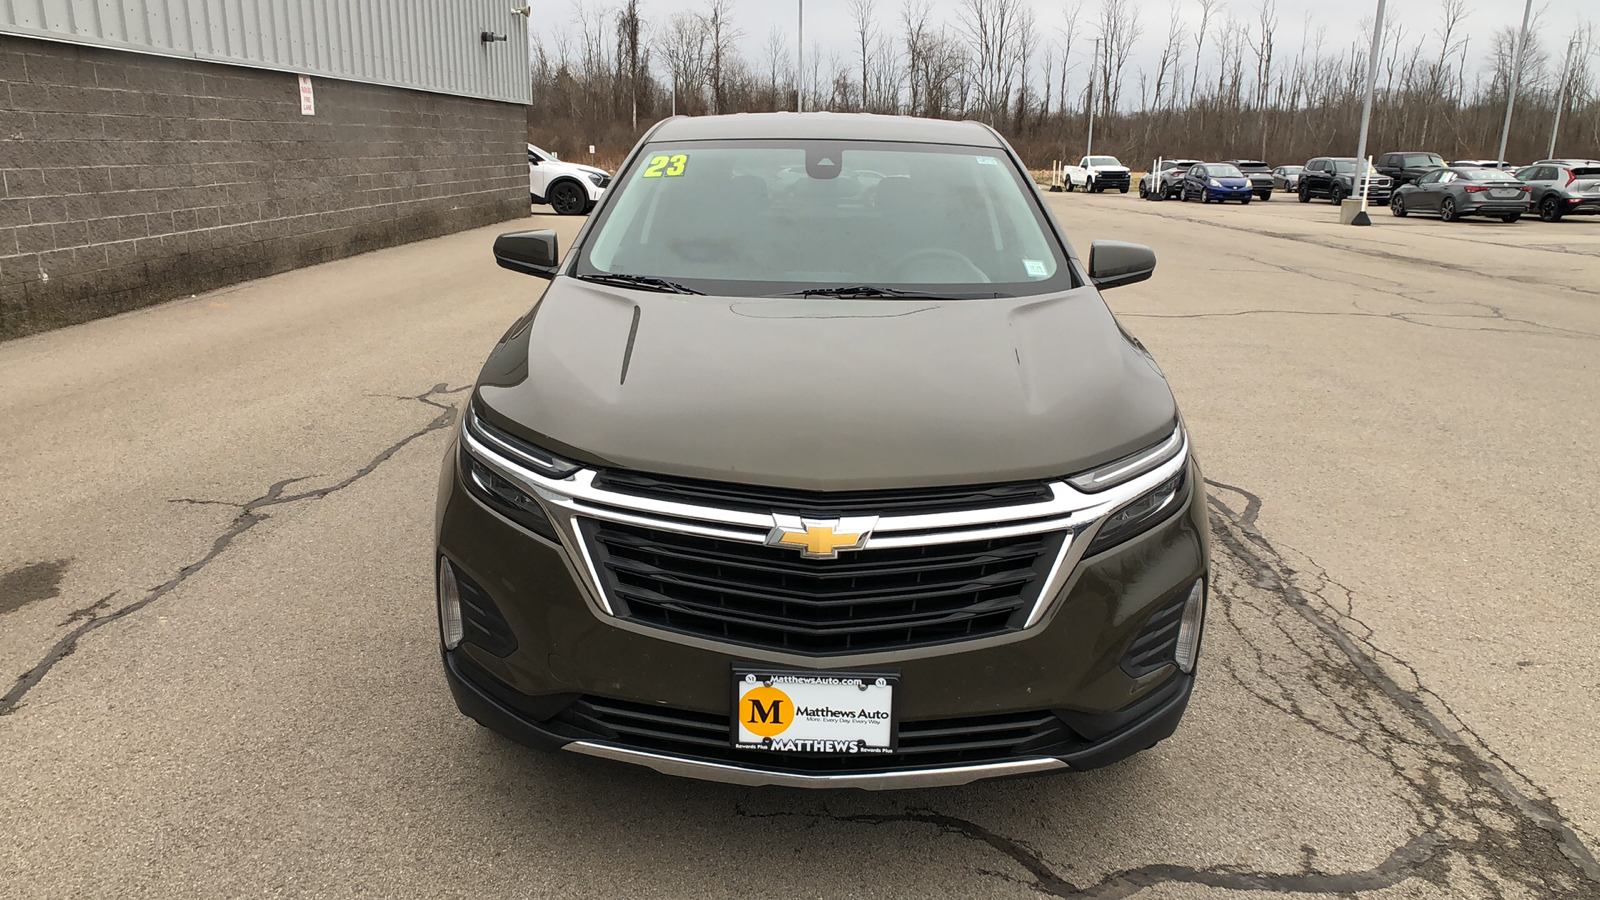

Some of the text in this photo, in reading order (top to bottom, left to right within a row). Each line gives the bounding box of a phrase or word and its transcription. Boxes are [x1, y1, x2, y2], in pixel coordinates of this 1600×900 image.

[642, 154, 688, 178] 23
[770, 675, 862, 686] MatthewsAuto.com
[747, 699, 784, 724] M
[795, 706, 889, 720] Matthews Auto
[770, 739, 858, 753] MATTHEWS
